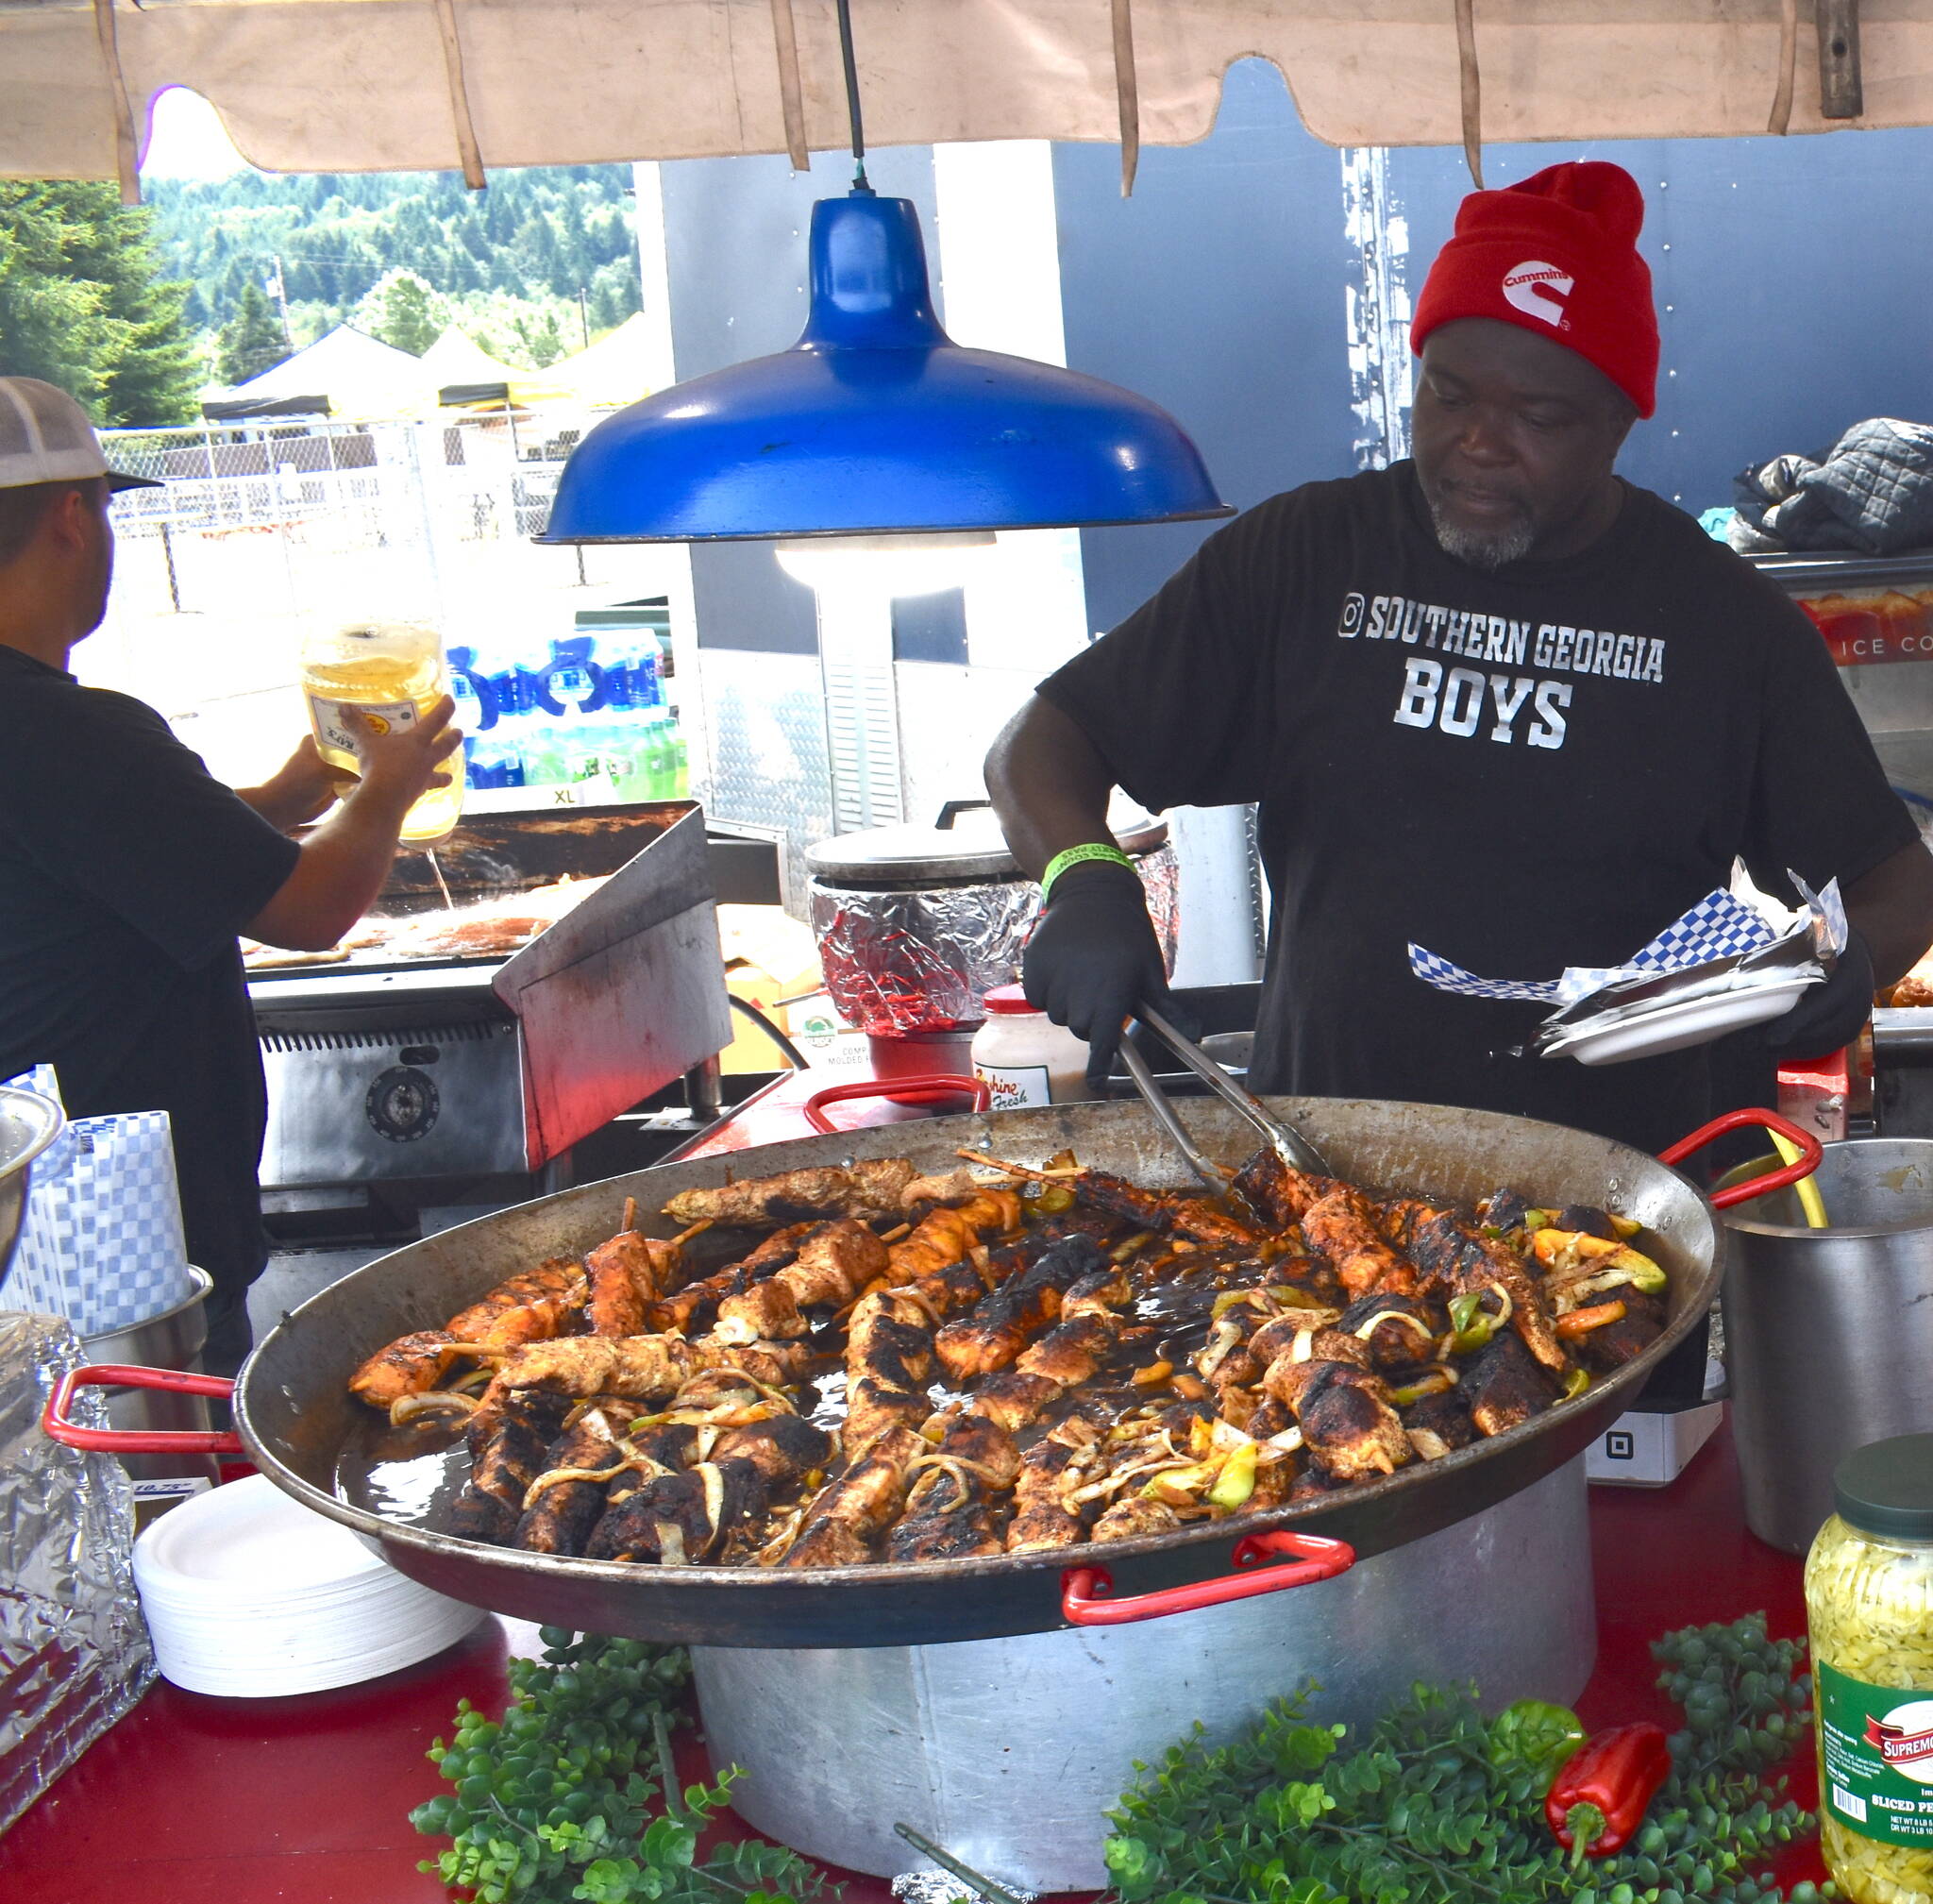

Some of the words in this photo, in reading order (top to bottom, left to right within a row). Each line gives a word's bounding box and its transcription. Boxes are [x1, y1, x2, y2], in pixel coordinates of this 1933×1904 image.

[1504, 269, 1569, 287] Cummins
[1366, 595, 1530, 666] SOUTHERN
[1534, 623, 1666, 683] GEORGIA
[1842, 639, 1884, 656] ICE
[1393, 657, 1573, 750] BOYS
[554, 790, 575, 804] XL
[828, 1056, 863, 1066] MOLDED
[993, 1089, 1028, 1109] Fresh
[1872, 1794, 1915, 1811] SLICED
[1891, 1815, 1903, 1824] NET
[1891, 1823, 1900, 1832] DR
[1900, 1826, 1910, 1834] WT
[1916, 1827, 1925, 1835] LB
